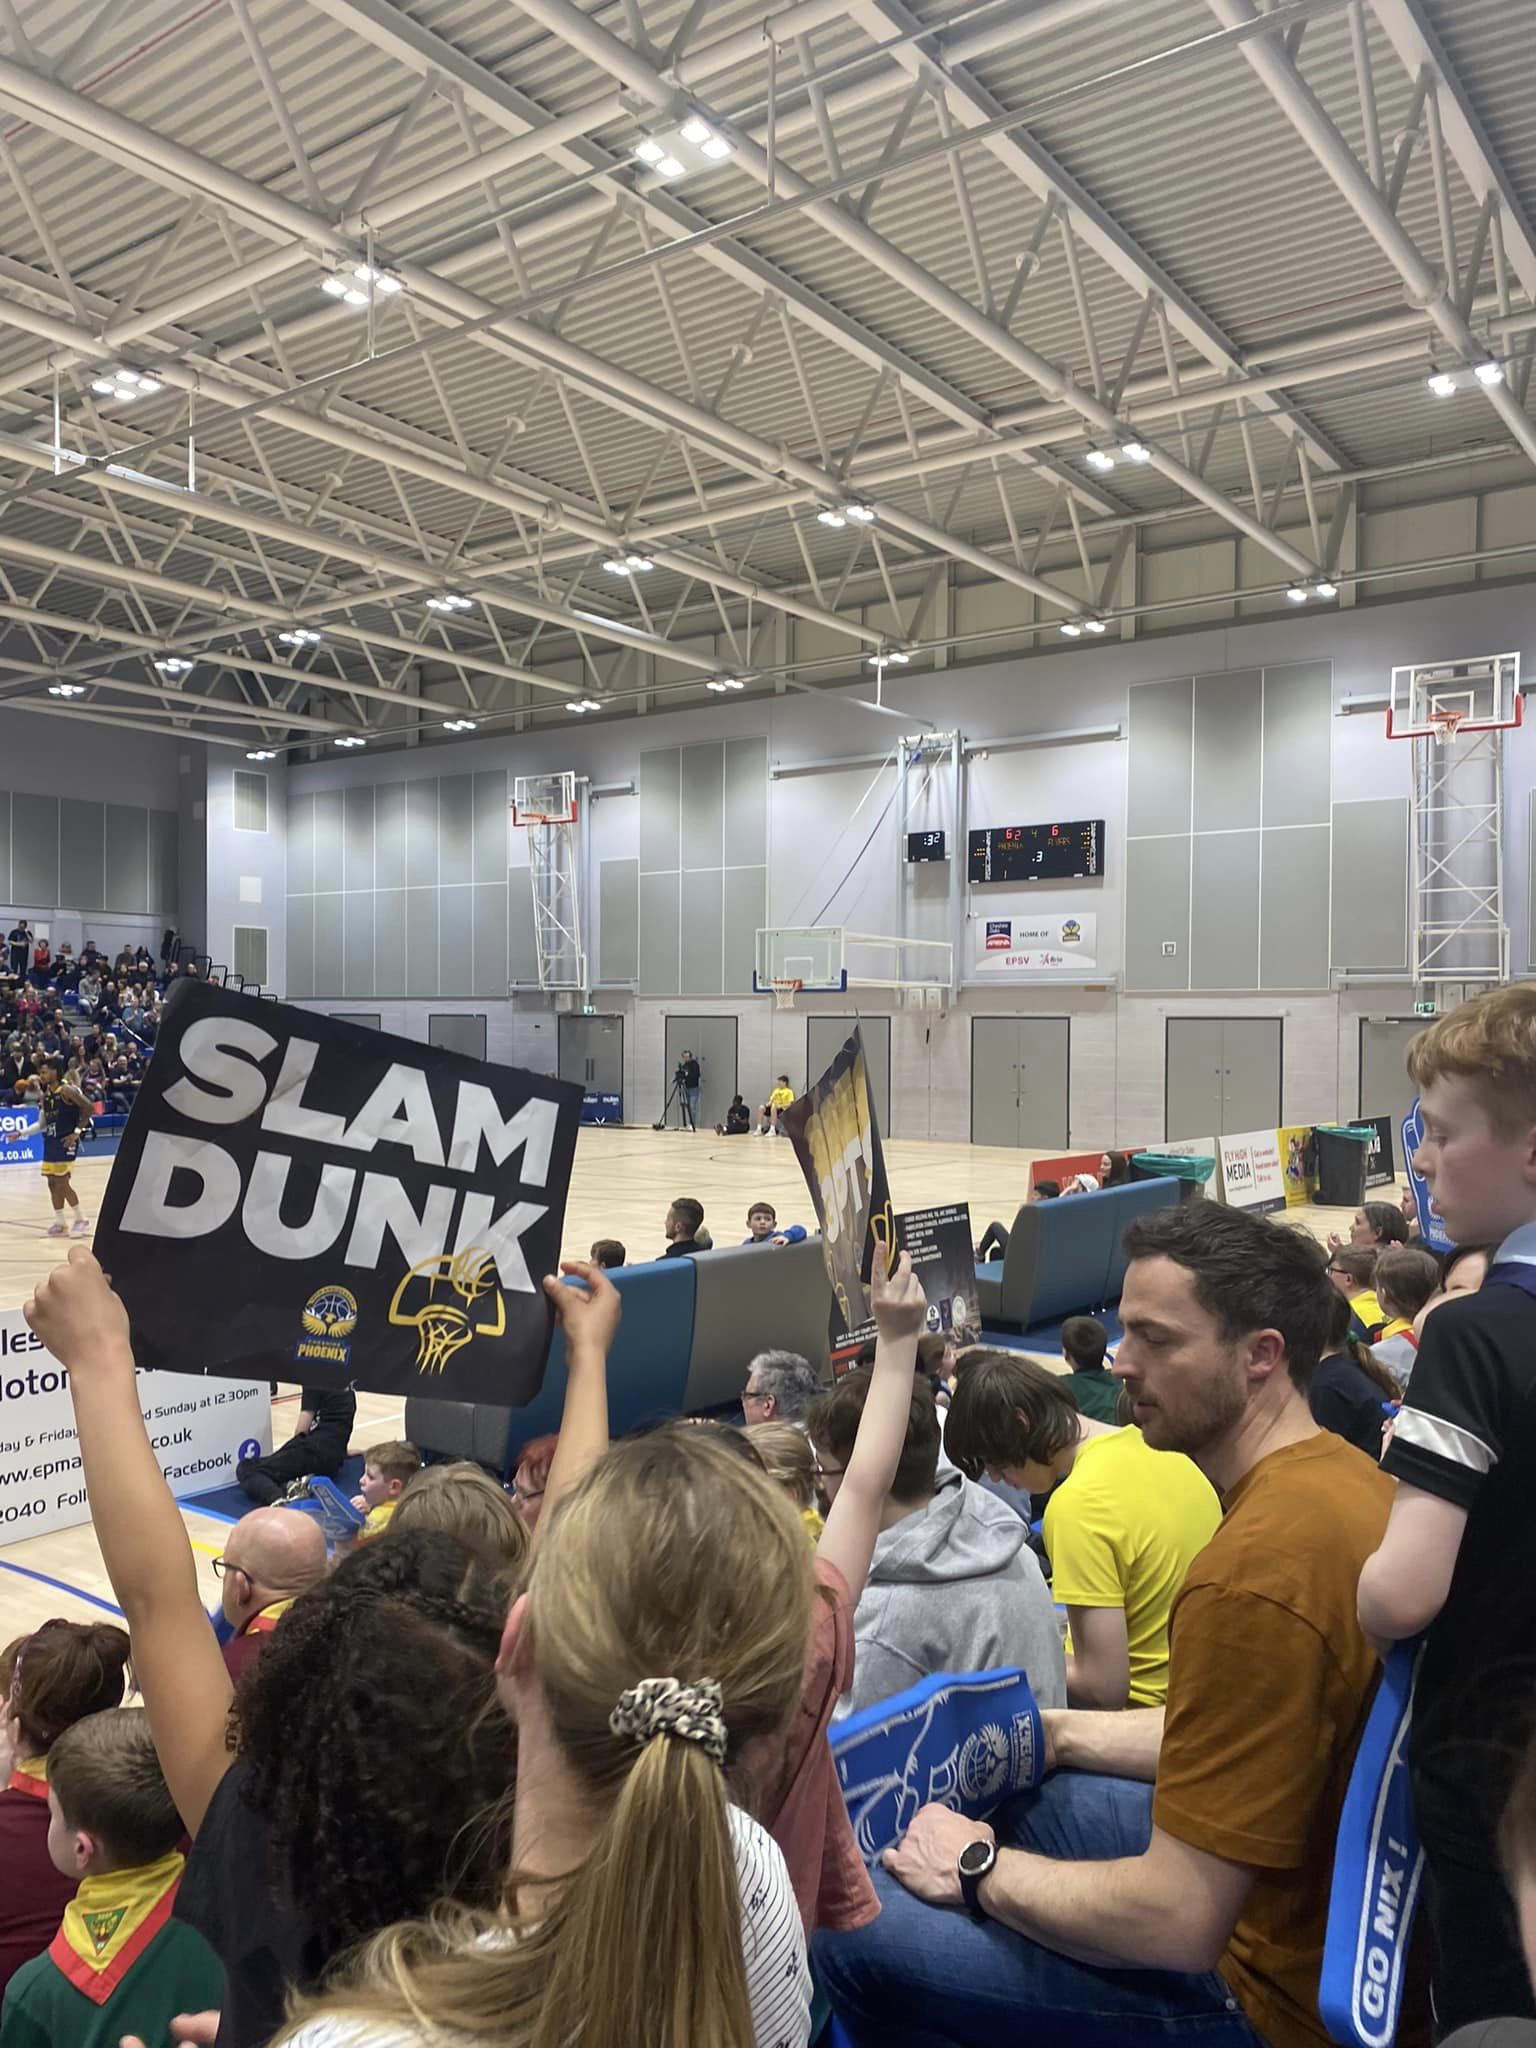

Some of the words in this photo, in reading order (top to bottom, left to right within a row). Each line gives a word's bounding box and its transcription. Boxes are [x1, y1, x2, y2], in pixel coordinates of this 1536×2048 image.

[1005, 828, 1022, 841] 62
[1005, 956, 1030, 966] EPSV
[161, 1016, 560, 1188] SLAM
[0, 1115, 28, 1132] en
[1226, 1162, 1251, 1182] MEDIA
[118, 1129, 550, 1294] DUNK
[297, 1343, 348, 1362] PHOENIX
[0, 1368, 69, 1402] otor
[25, 1434, 35, 1447] &
[39, 1428, 79, 1445] Friday
[155, 1401, 197, 1419] Sunday
[199, 1396, 212, 1408] at
[214, 1387, 259, 1406] 12.30pm
[163, 1452, 232, 1481] Facebook
[1373, 1864, 1405, 1942] NIX
[1362, 1950, 1390, 2019] GO
